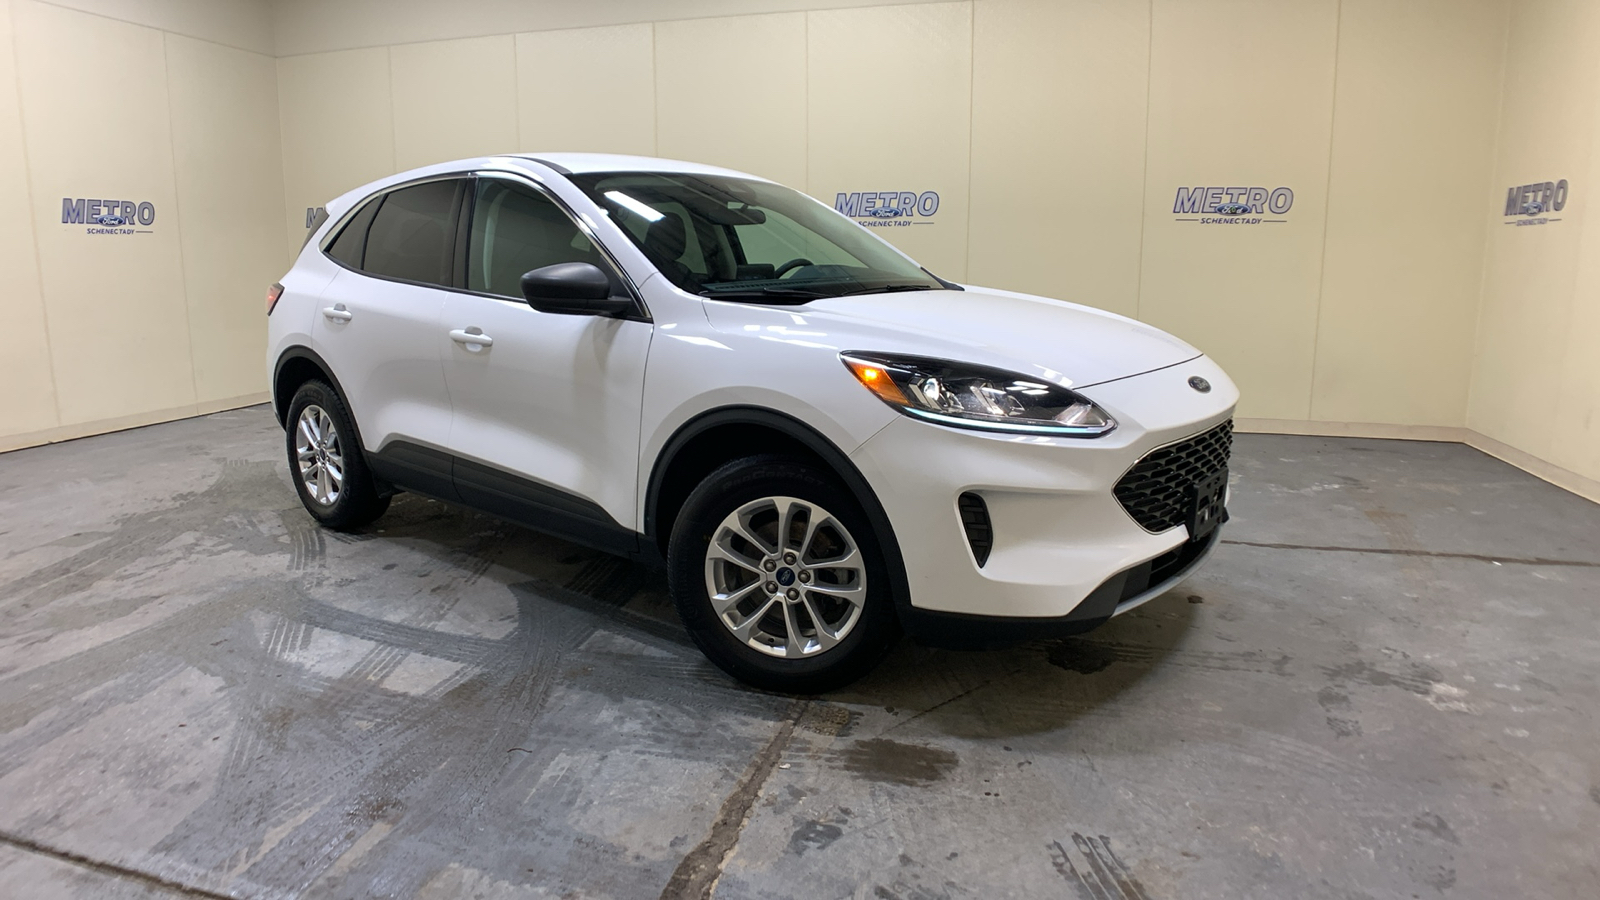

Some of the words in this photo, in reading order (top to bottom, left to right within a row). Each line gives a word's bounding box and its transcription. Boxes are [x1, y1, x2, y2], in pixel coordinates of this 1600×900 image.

[835, 191, 940, 217] METRO
[1172, 187, 1294, 215] METRO
[1504, 179, 1569, 216] METRO
[61, 198, 155, 226] METRO
[1200, 217, 1262, 225] SCHENECTADY
